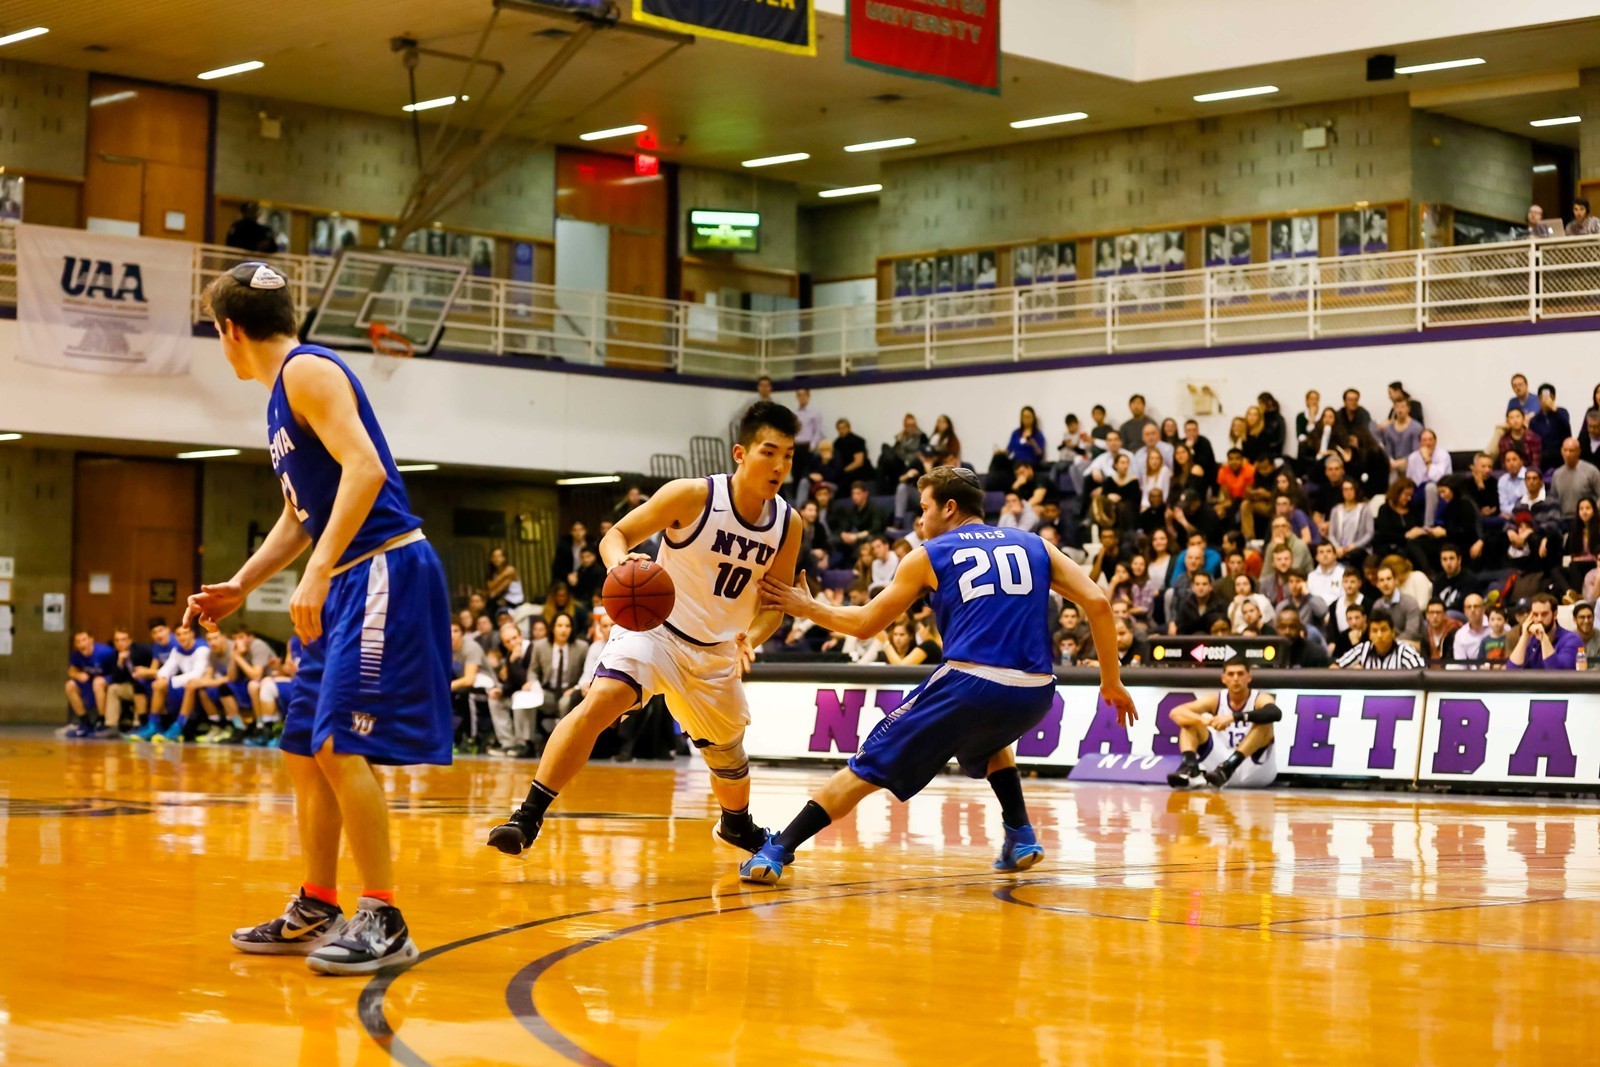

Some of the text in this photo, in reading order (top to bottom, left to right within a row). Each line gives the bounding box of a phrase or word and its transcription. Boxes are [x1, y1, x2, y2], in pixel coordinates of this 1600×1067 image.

[865, 1, 982, 44] UNIVERSITY
[61, 255, 149, 303] UAA
[711, 529, 776, 567] NYU
[957, 530, 1006, 540] MACS
[713, 562, 752, 600] 10
[951, 544, 1034, 604] 20
[1203, 646, 1226, 660] POSS
[1097, 753, 1164, 770] NYU
